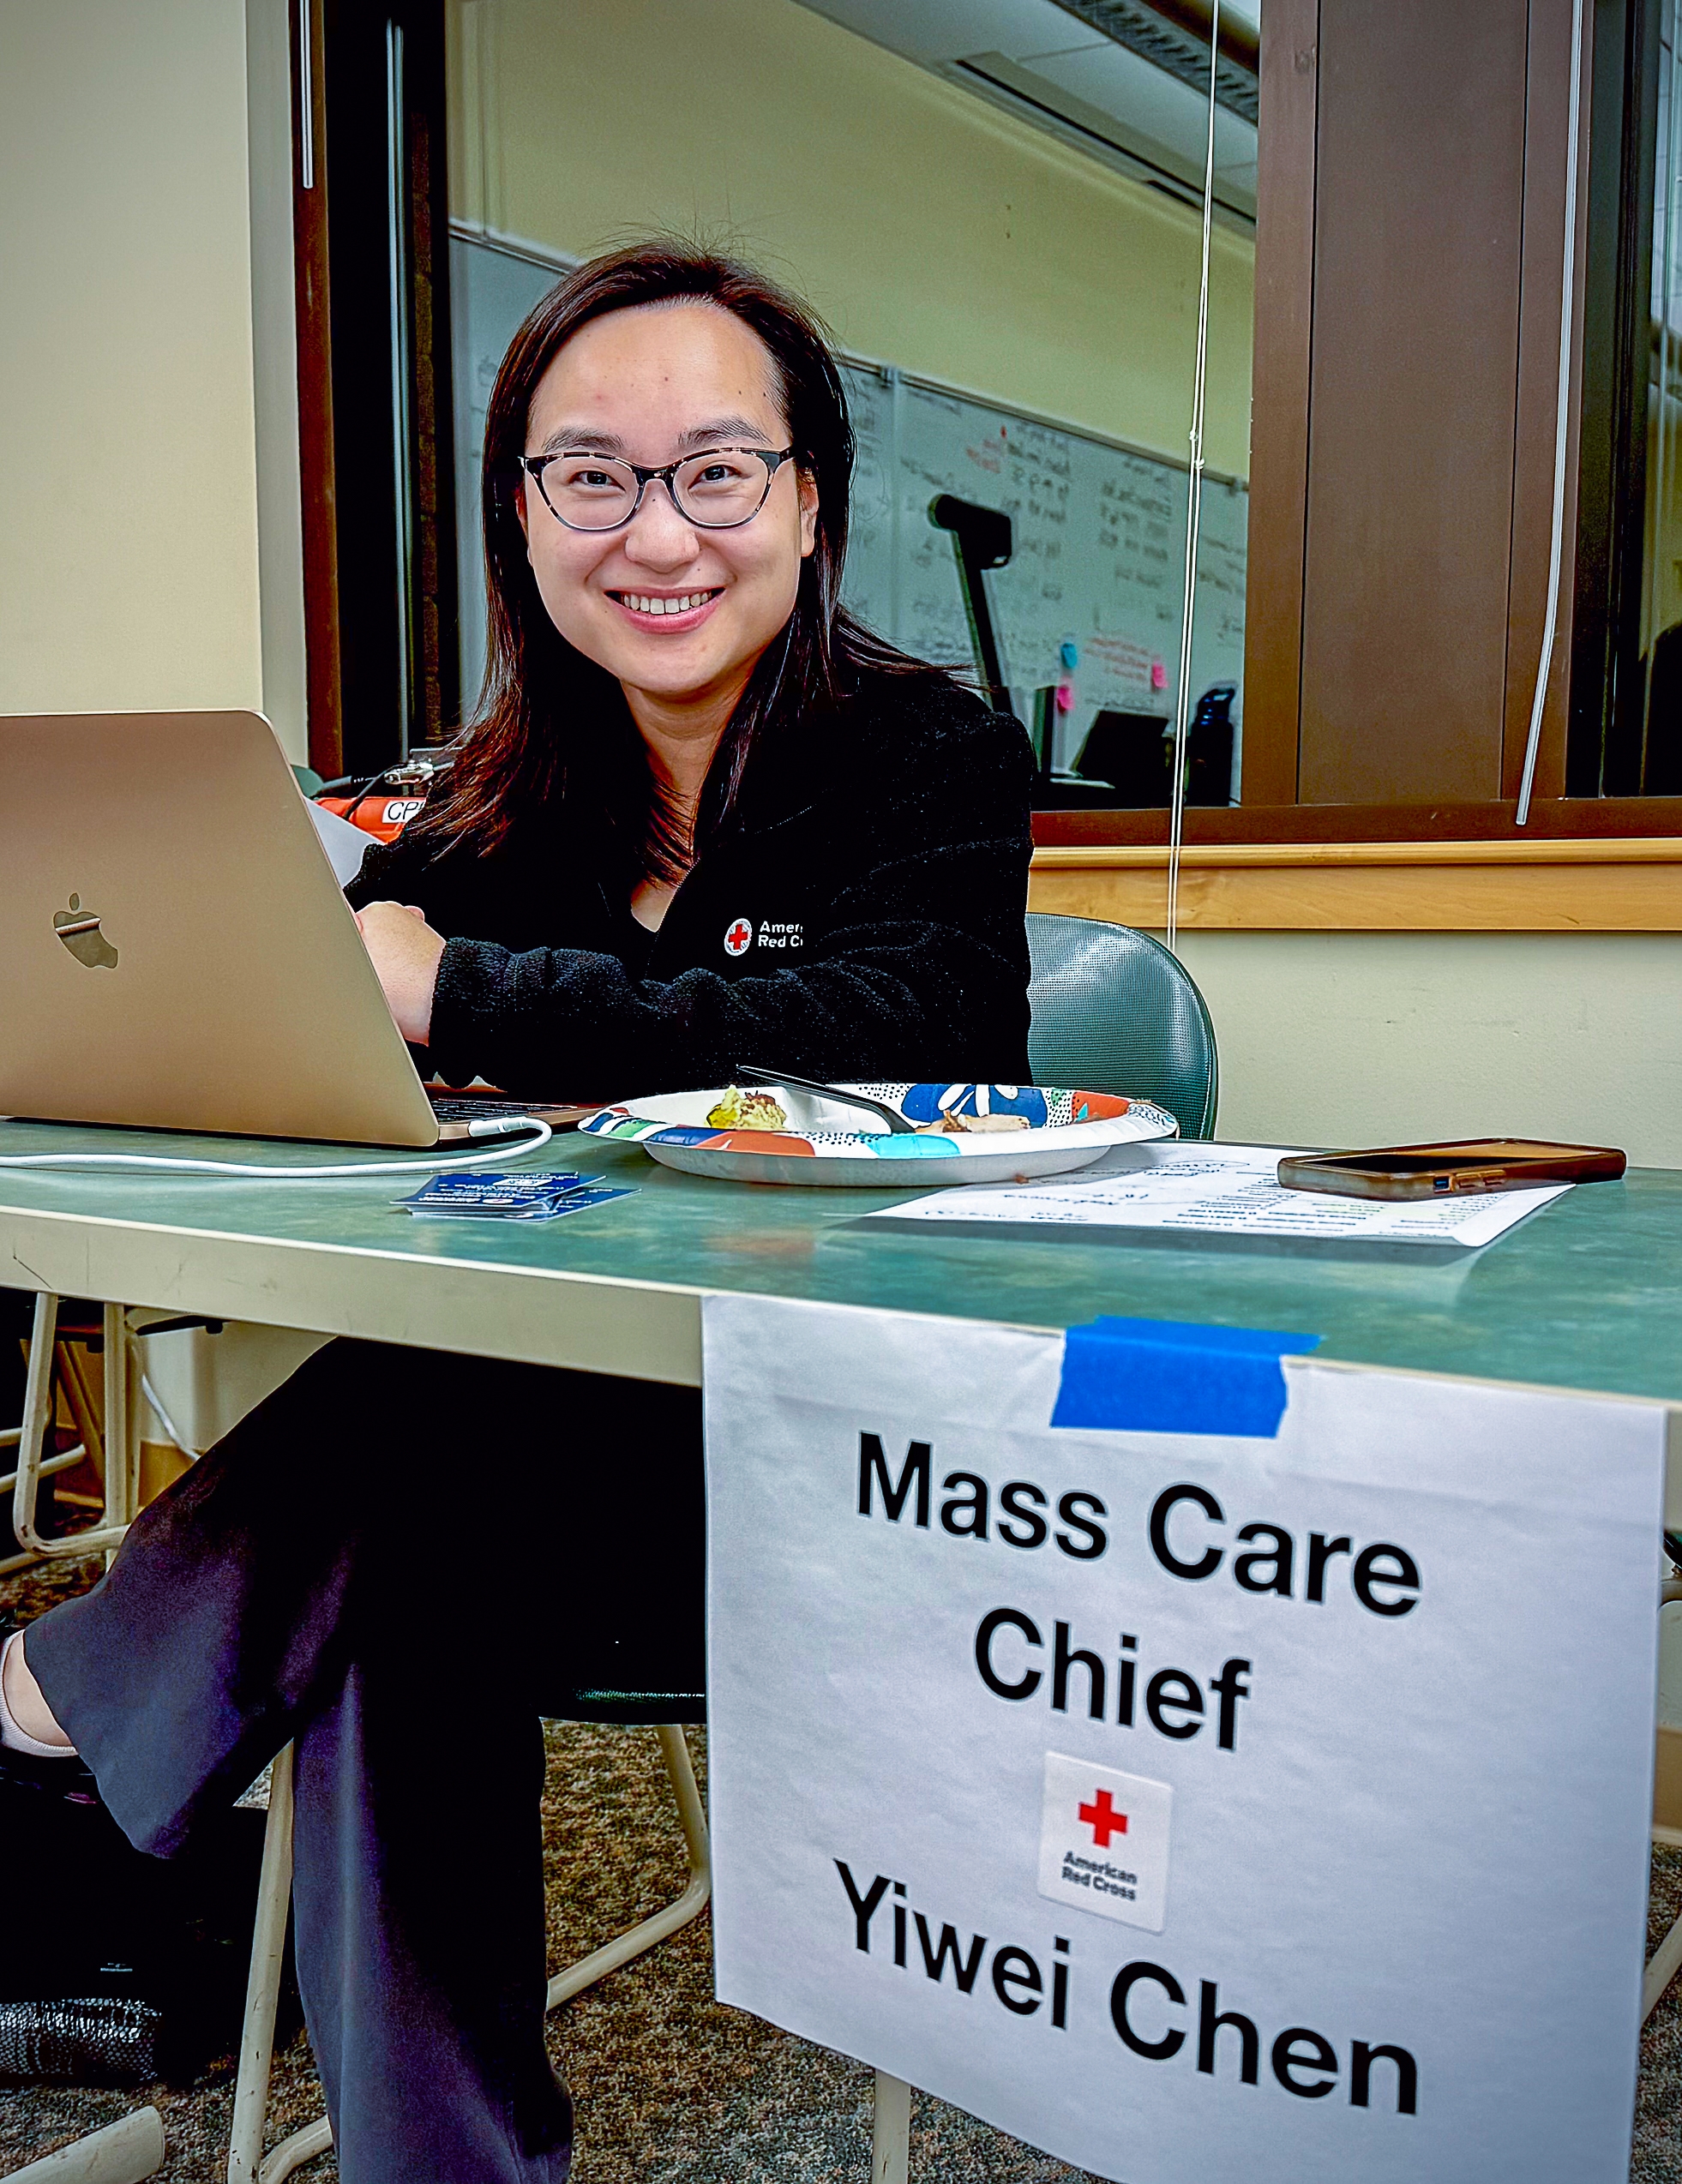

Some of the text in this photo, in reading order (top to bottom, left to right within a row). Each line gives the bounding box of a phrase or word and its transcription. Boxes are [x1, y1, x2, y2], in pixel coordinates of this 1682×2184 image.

[758, 934, 786, 948] Red
[859, 1432, 1419, 1616] Mass Care
[976, 1608, 1250, 1750] Chief
[1061, 1865, 1136, 1900] Red Cross
[1063, 1850, 1138, 1885] American
[833, 1857, 1417, 2115] Yiwei Chen
